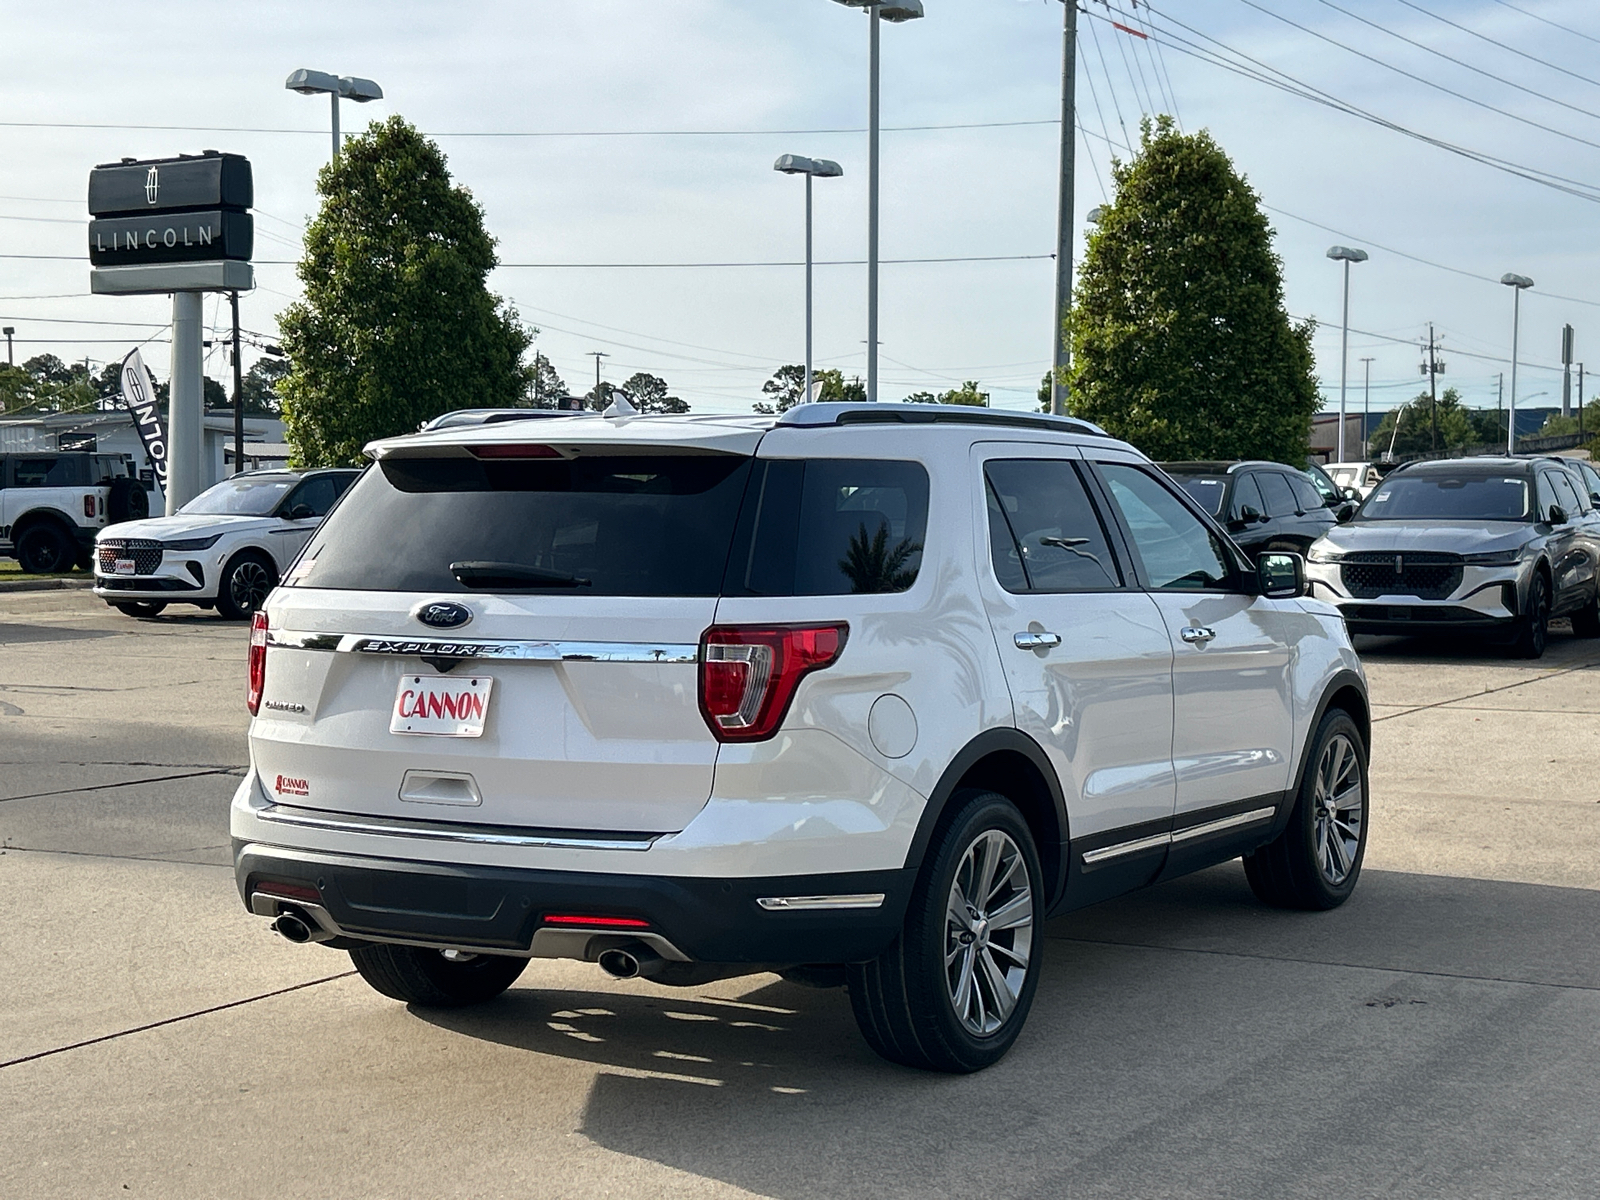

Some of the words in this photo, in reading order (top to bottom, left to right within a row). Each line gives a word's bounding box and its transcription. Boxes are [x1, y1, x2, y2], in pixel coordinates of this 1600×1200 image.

[97, 226, 212, 252] LINCOLN
[425, 605, 457, 622] Ford
[363, 641, 520, 656] EXPLORER
[398, 689, 486, 720] CANNON
[282, 777, 309, 790] CANNON
